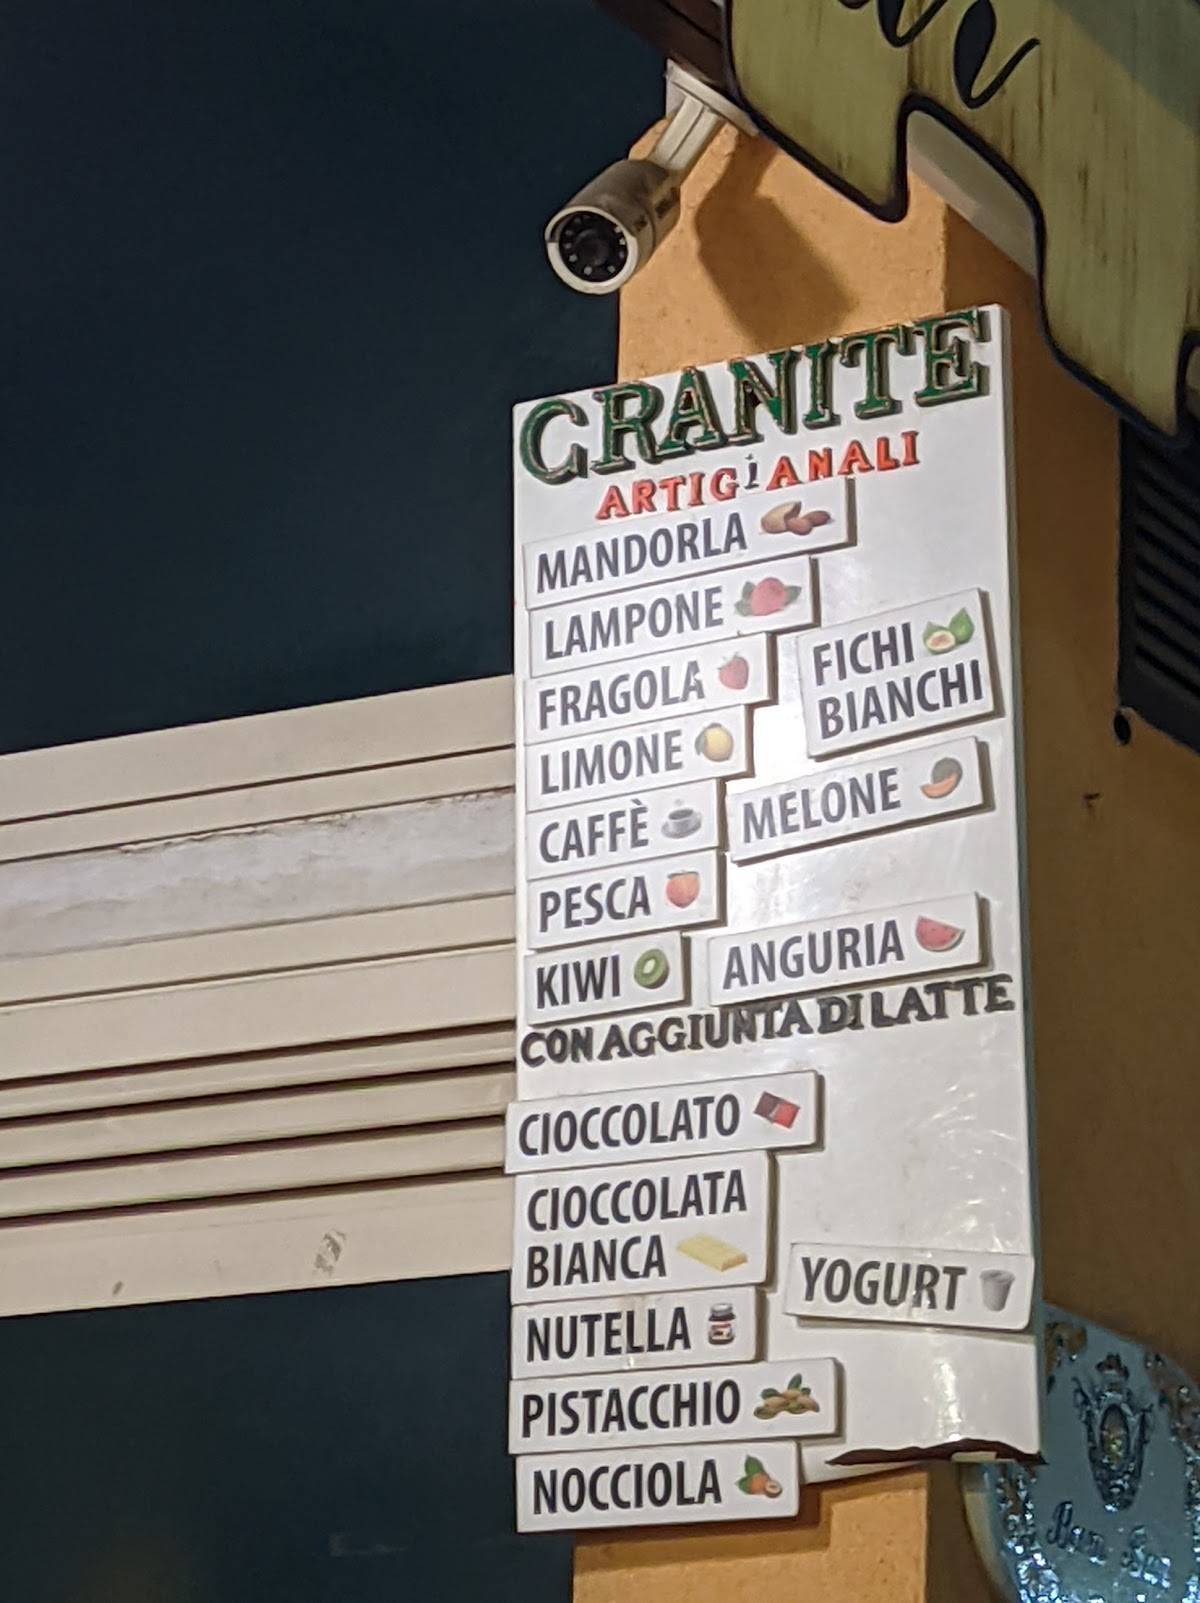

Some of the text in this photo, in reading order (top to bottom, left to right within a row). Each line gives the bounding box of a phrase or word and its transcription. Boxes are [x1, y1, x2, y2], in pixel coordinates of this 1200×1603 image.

[520, 310, 987, 485] GRANITE
[537, 512, 747, 593] MANDORLA
[544, 586, 723, 660] LAMPONE
[812, 622, 914, 686] FICHI
[539, 661, 705, 730] FRAGOLA
[819, 659, 983, 739] BIANCHI
[541, 730, 683, 794] LIMONE
[539, 800, 649, 863] CAFFÈ
[743, 768, 901, 843] MELONE
[539, 877, 651, 933] PESCA
[537, 955, 621, 1009] KIWI
[723, 920, 904, 990] ANGURIA
[520, 973, 1016, 1067] CON AGGIUNTA DI LATTE
[519, 1093, 740, 1156] CIOCCOLATO
[527, 1169, 747, 1232] CIOCCOLATA
[526, 1235, 667, 1289] BIANCA
[801, 1256, 967, 1311] YOGURT
[526, 1306, 692, 1362] NUTELLA
[522, 1379, 741, 1438] PISTACCHIO
[533, 1458, 722, 1515] NOCCIOLA
